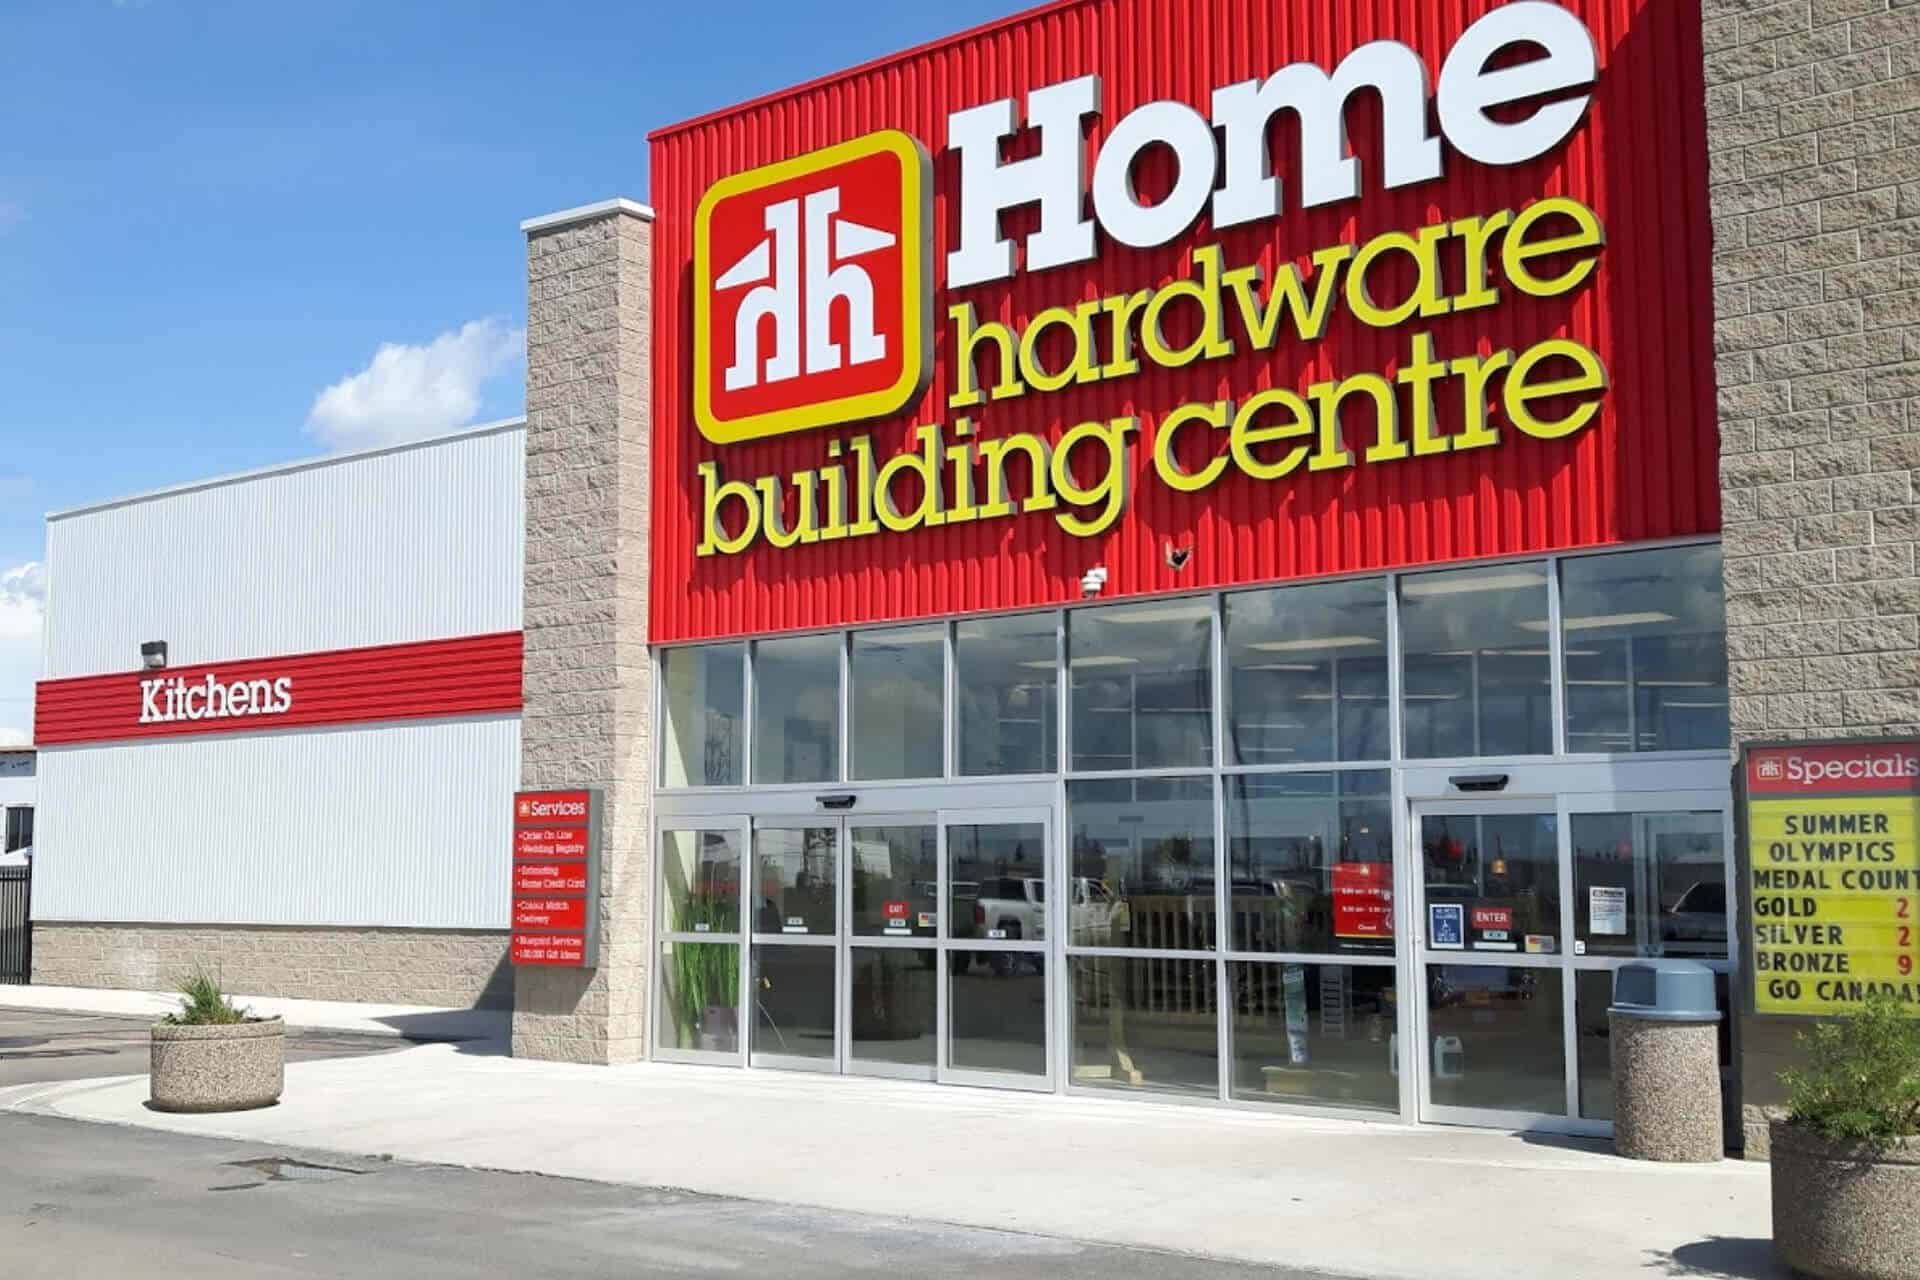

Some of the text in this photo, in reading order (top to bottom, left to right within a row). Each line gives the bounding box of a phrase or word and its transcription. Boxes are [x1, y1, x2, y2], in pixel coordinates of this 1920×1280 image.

[947, 0, 1599, 290] Home
[949, 198, 1605, 408] hardware
[697, 331, 1610, 558] building centre
[139, 674, 292, 723] Kitchens
[1787, 753, 1920, 784] Specials
[531, 800, 585, 816] Services
[1785, 814, 1889, 835] SUMMER
[1769, 842, 1895, 862] OLYMPICS
[1754, 871, 1831, 889] MEDAL
[1476, 912, 1507, 922] ENTER
[1754, 898, 1909, 918] GOLD 2
[1756, 925, 1910, 946] SILVER 2
[1757, 953, 1912, 976] BRONZE 9
[1769, 980, 1801, 1000] GO
